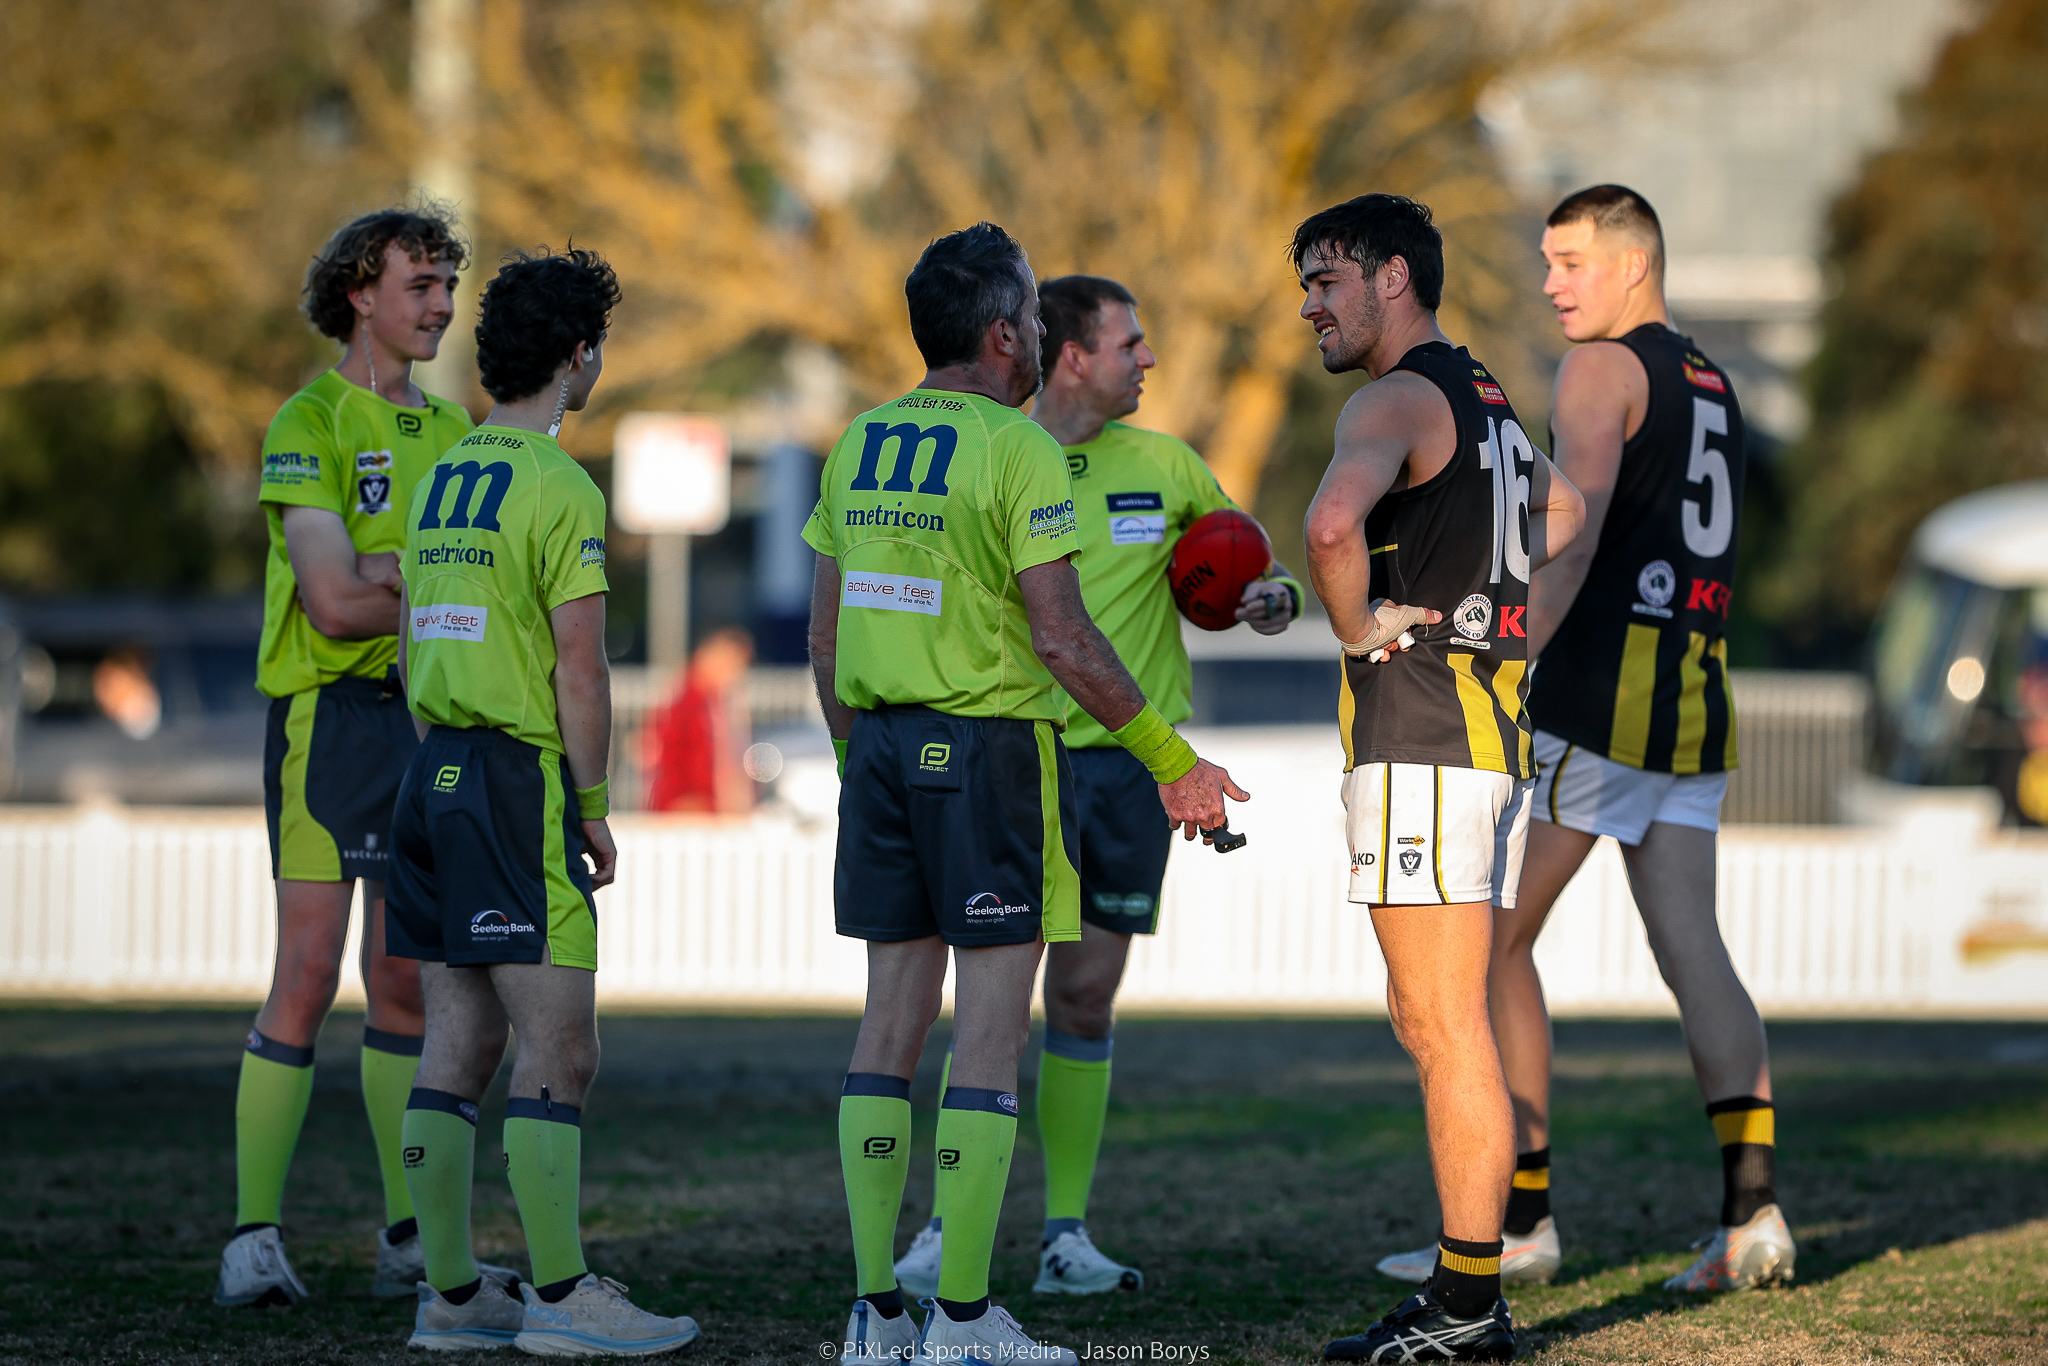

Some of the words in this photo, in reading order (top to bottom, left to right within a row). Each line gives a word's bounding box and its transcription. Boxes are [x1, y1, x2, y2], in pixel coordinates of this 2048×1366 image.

[898, 397, 920, 408] GFUL
[922, 397, 938, 409] Est
[938, 400, 967, 412] 1935
[483, 434, 499, 445] Est
[498, 436, 525, 450] 1935
[1682, 396, 1733, 558] 5
[1478, 416, 1534, 584] 16
[845, 501, 945, 532] metricon
[1029, 499, 1074, 524] PROMO
[1030, 518, 1061, 531] GEELONG
[1049, 532, 1060, 540] PH
[847, 580, 895, 595] active
[903, 584, 936, 600] feet
[445, 611, 479, 627] feet
[1352, 853, 1375, 865] AKD
[966, 906, 1005, 916] Geelong
[1005, 904, 1030, 914] Bank
[471, 924, 510, 934] Geelong
[510, 923, 535, 933] Bank
[526, 1305, 573, 1328] HOKA
